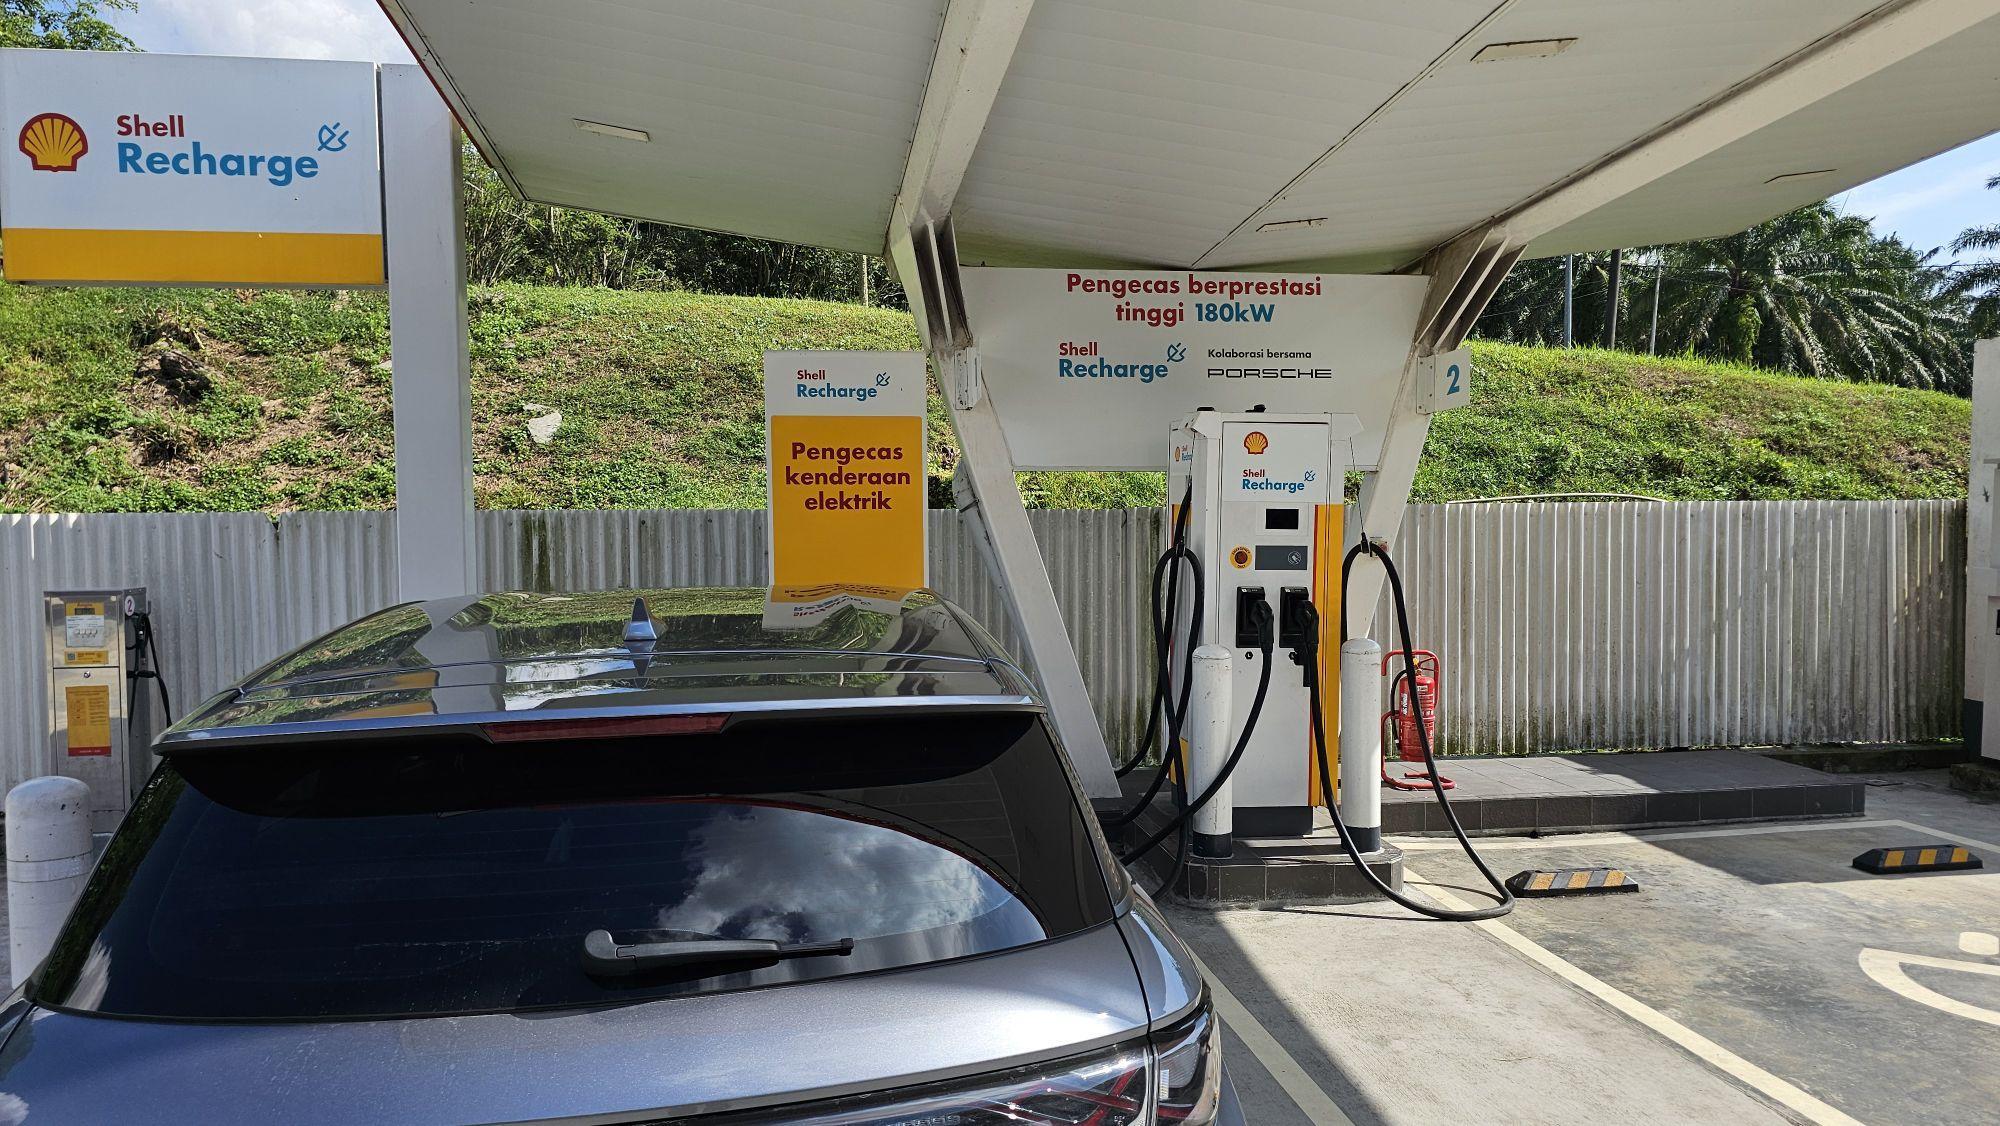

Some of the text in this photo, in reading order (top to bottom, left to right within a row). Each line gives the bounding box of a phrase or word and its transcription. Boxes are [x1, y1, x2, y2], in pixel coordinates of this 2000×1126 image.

[116, 114, 185, 138] Shell
[117, 141, 319, 187] Recharge
[1067, 273, 1322, 300] Pengecas berprestasi
[1115, 301, 1275, 327] tinggi 180kW
[1059, 341, 1098, 356] Shell
[1207, 348, 1312, 359] Kolaborasi bersama
[797, 369, 826, 380] Shell
[1059, 357, 1168, 383] Recharge
[1207, 368, 1332, 379] PORSCHE
[1446, 363, 1461, 396] 2
[796, 382, 878, 401] Recharge
[791, 442, 904, 466] Pengecas
[785, 465, 911, 485] kenderaan
[1242, 468, 1265, 478] Shell
[1242, 478, 1304, 493] Recharge
[804, 490, 893, 510] elektrik
